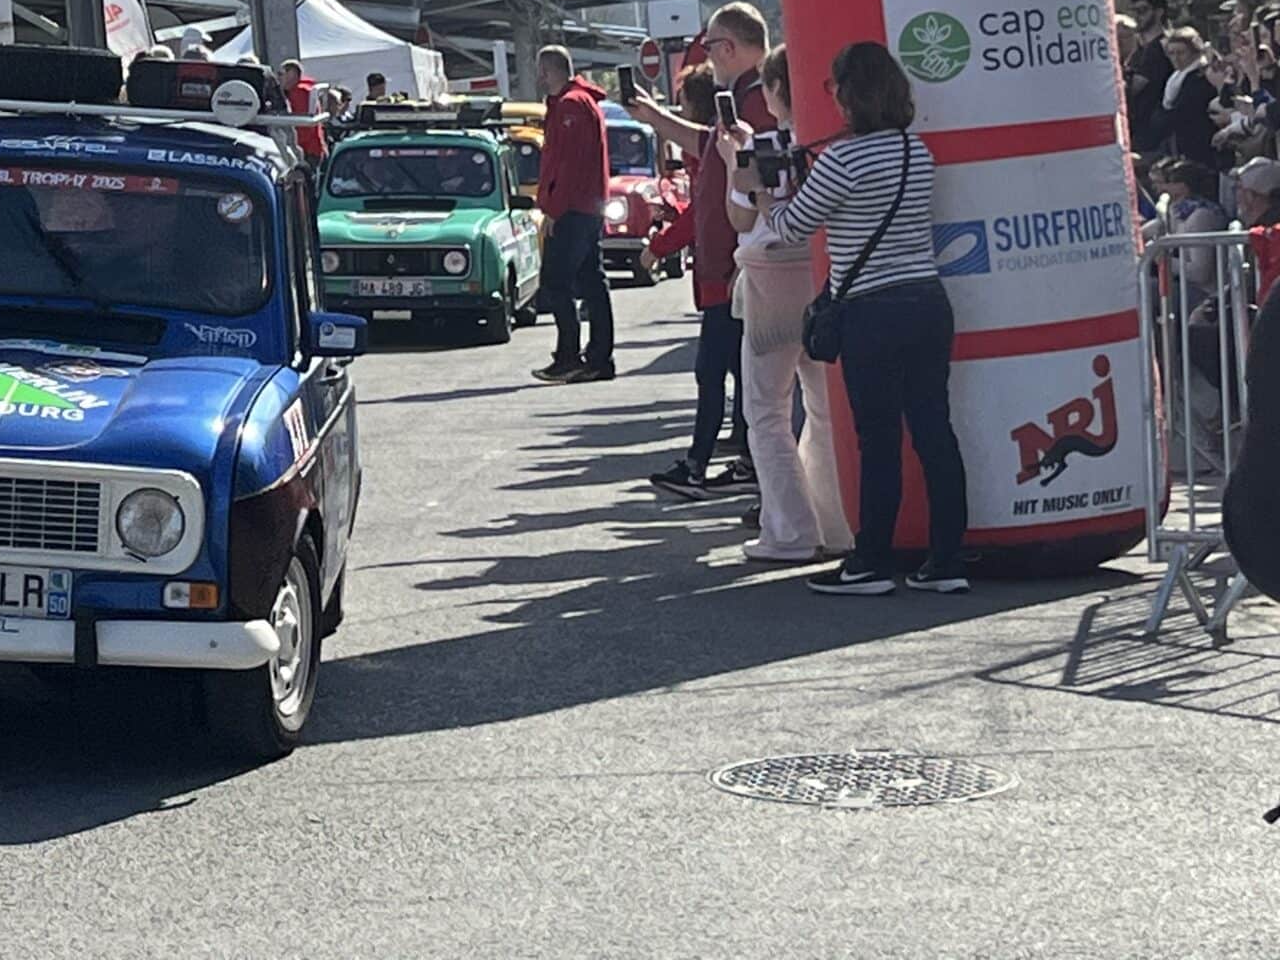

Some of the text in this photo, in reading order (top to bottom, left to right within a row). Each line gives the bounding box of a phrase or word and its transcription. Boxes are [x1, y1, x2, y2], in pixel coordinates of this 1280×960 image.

[978, 3, 1100, 39] cap eco
[982, 32, 1110, 72] solidaire
[22, 171, 87, 188] TROPHY
[91, 176, 125, 190] 2025
[993, 202, 1125, 252] SURFRIDER
[997, 249, 1088, 271] FOUNDATION
[1013, 498, 1038, 515] HIT
[1042, 493, 1089, 513] MUSIC
[49, 597, 67, 614] 50
